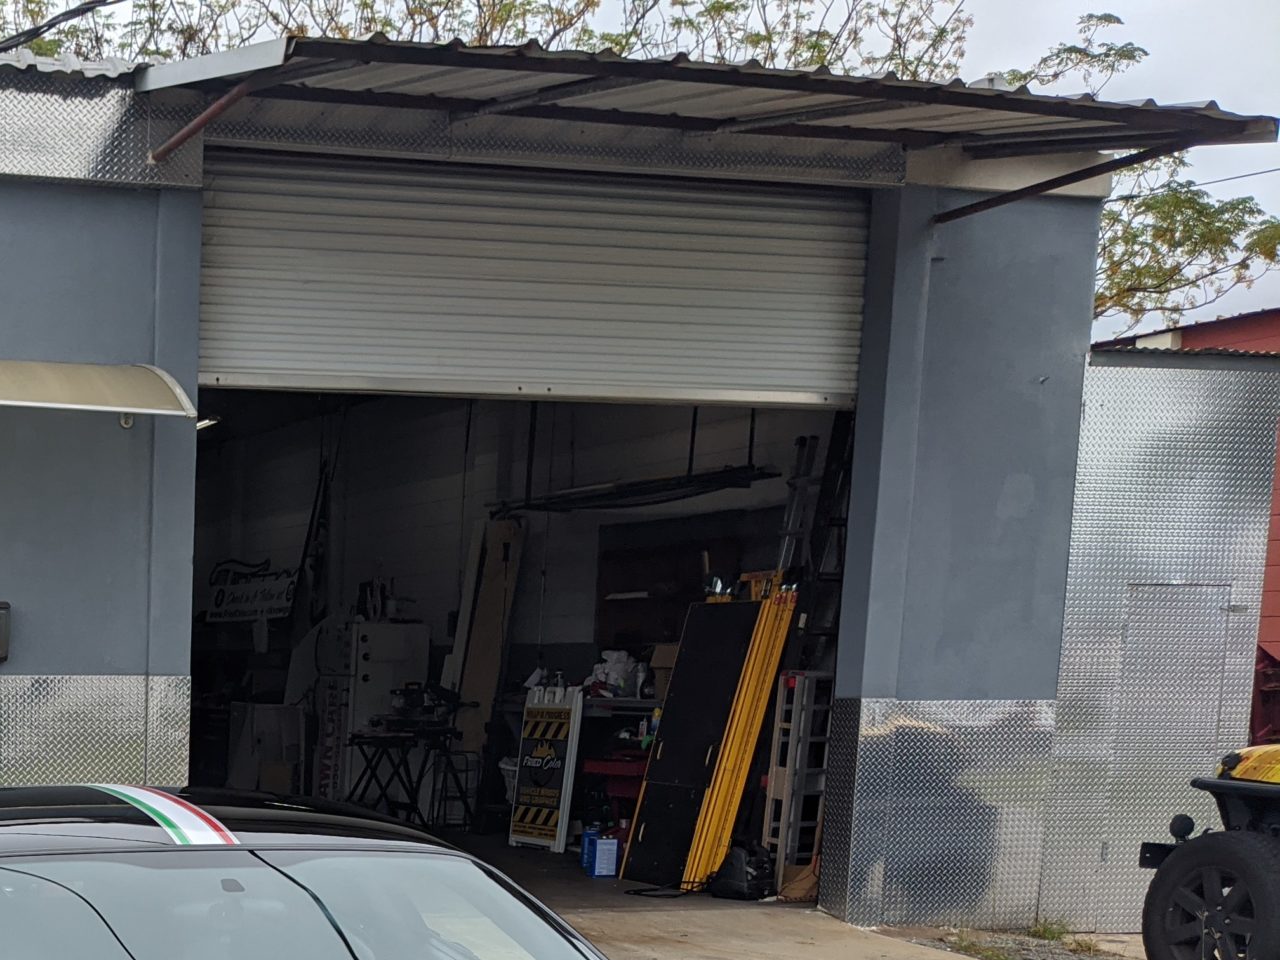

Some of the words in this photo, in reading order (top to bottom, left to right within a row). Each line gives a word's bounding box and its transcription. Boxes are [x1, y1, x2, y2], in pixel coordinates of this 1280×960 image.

[319, 745, 333, 799] AWN
[523, 756, 541, 767] FRIED
[543, 755, 561, 770] Color
